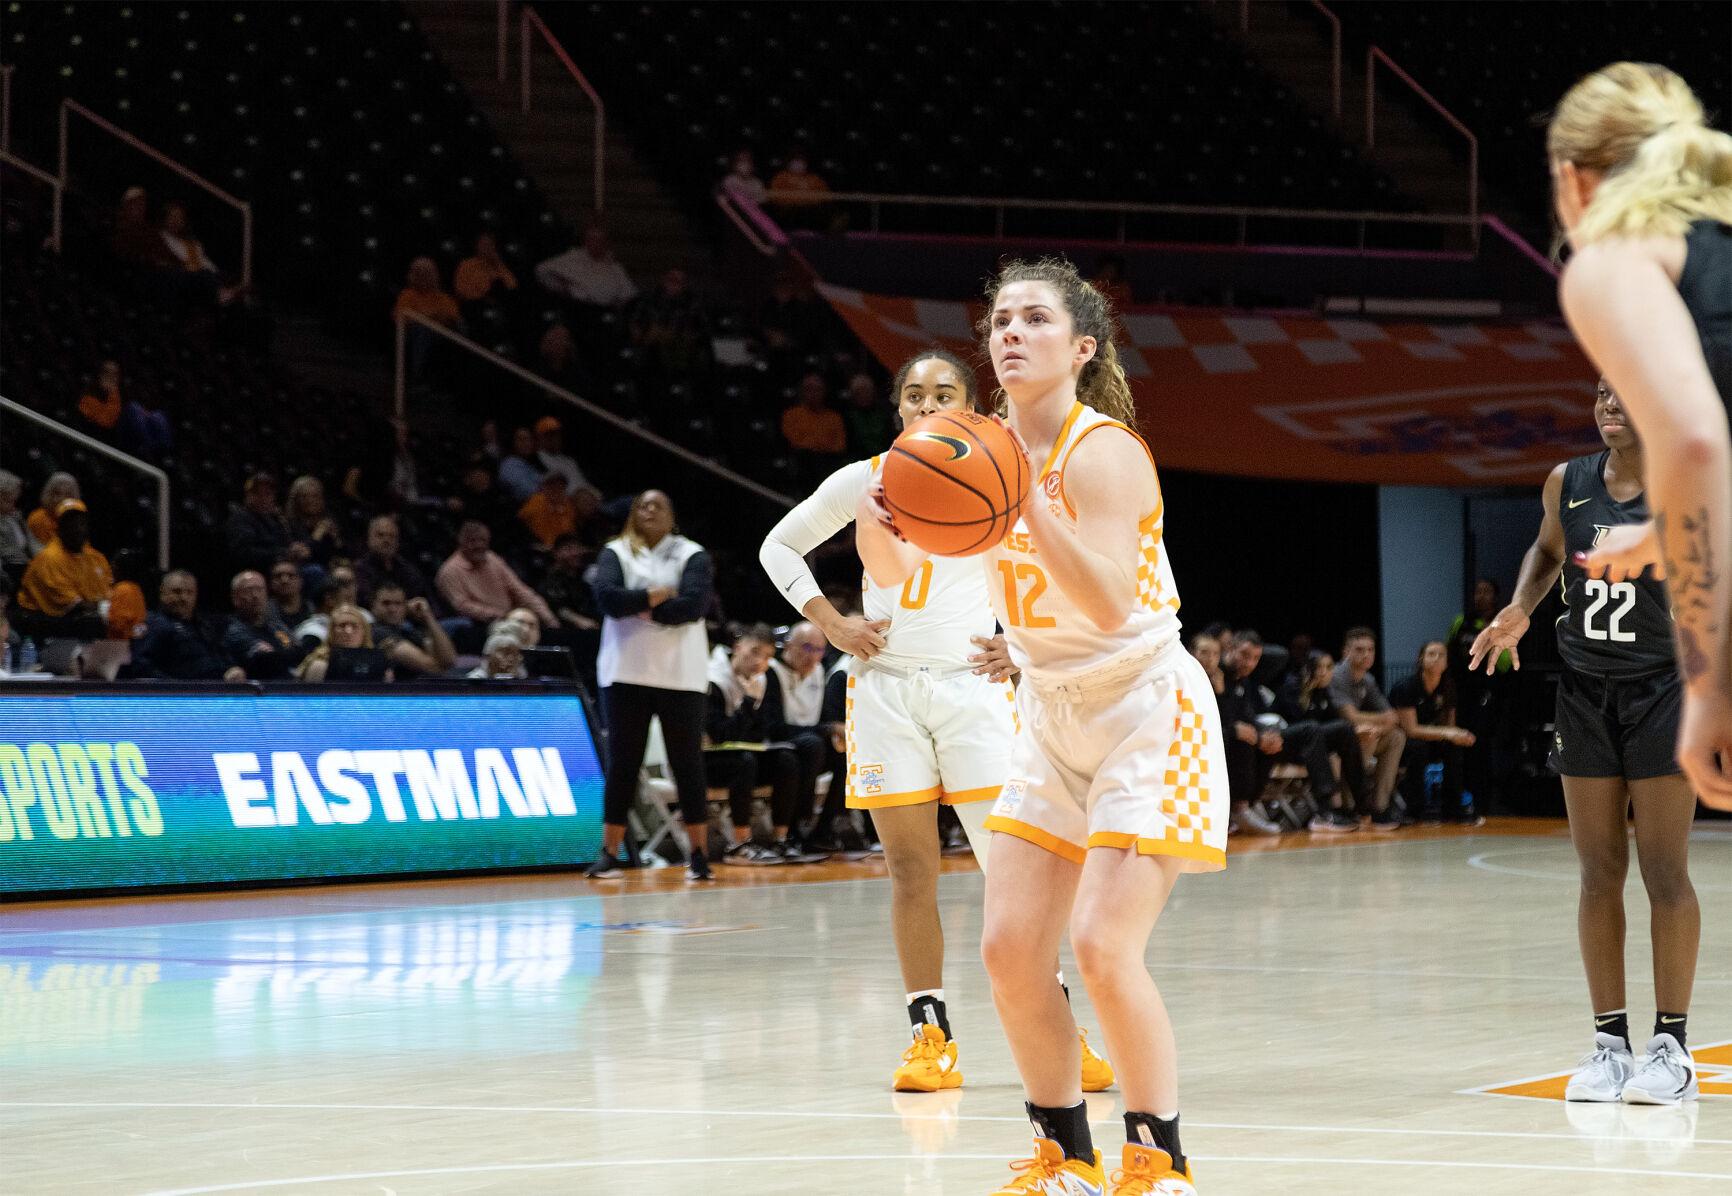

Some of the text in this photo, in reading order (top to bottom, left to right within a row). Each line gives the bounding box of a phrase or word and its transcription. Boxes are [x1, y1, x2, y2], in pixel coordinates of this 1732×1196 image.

[997, 559, 1057, 628] 12
[1583, 578, 1636, 642] 22
[212, 747, 578, 828] EASTMAN
